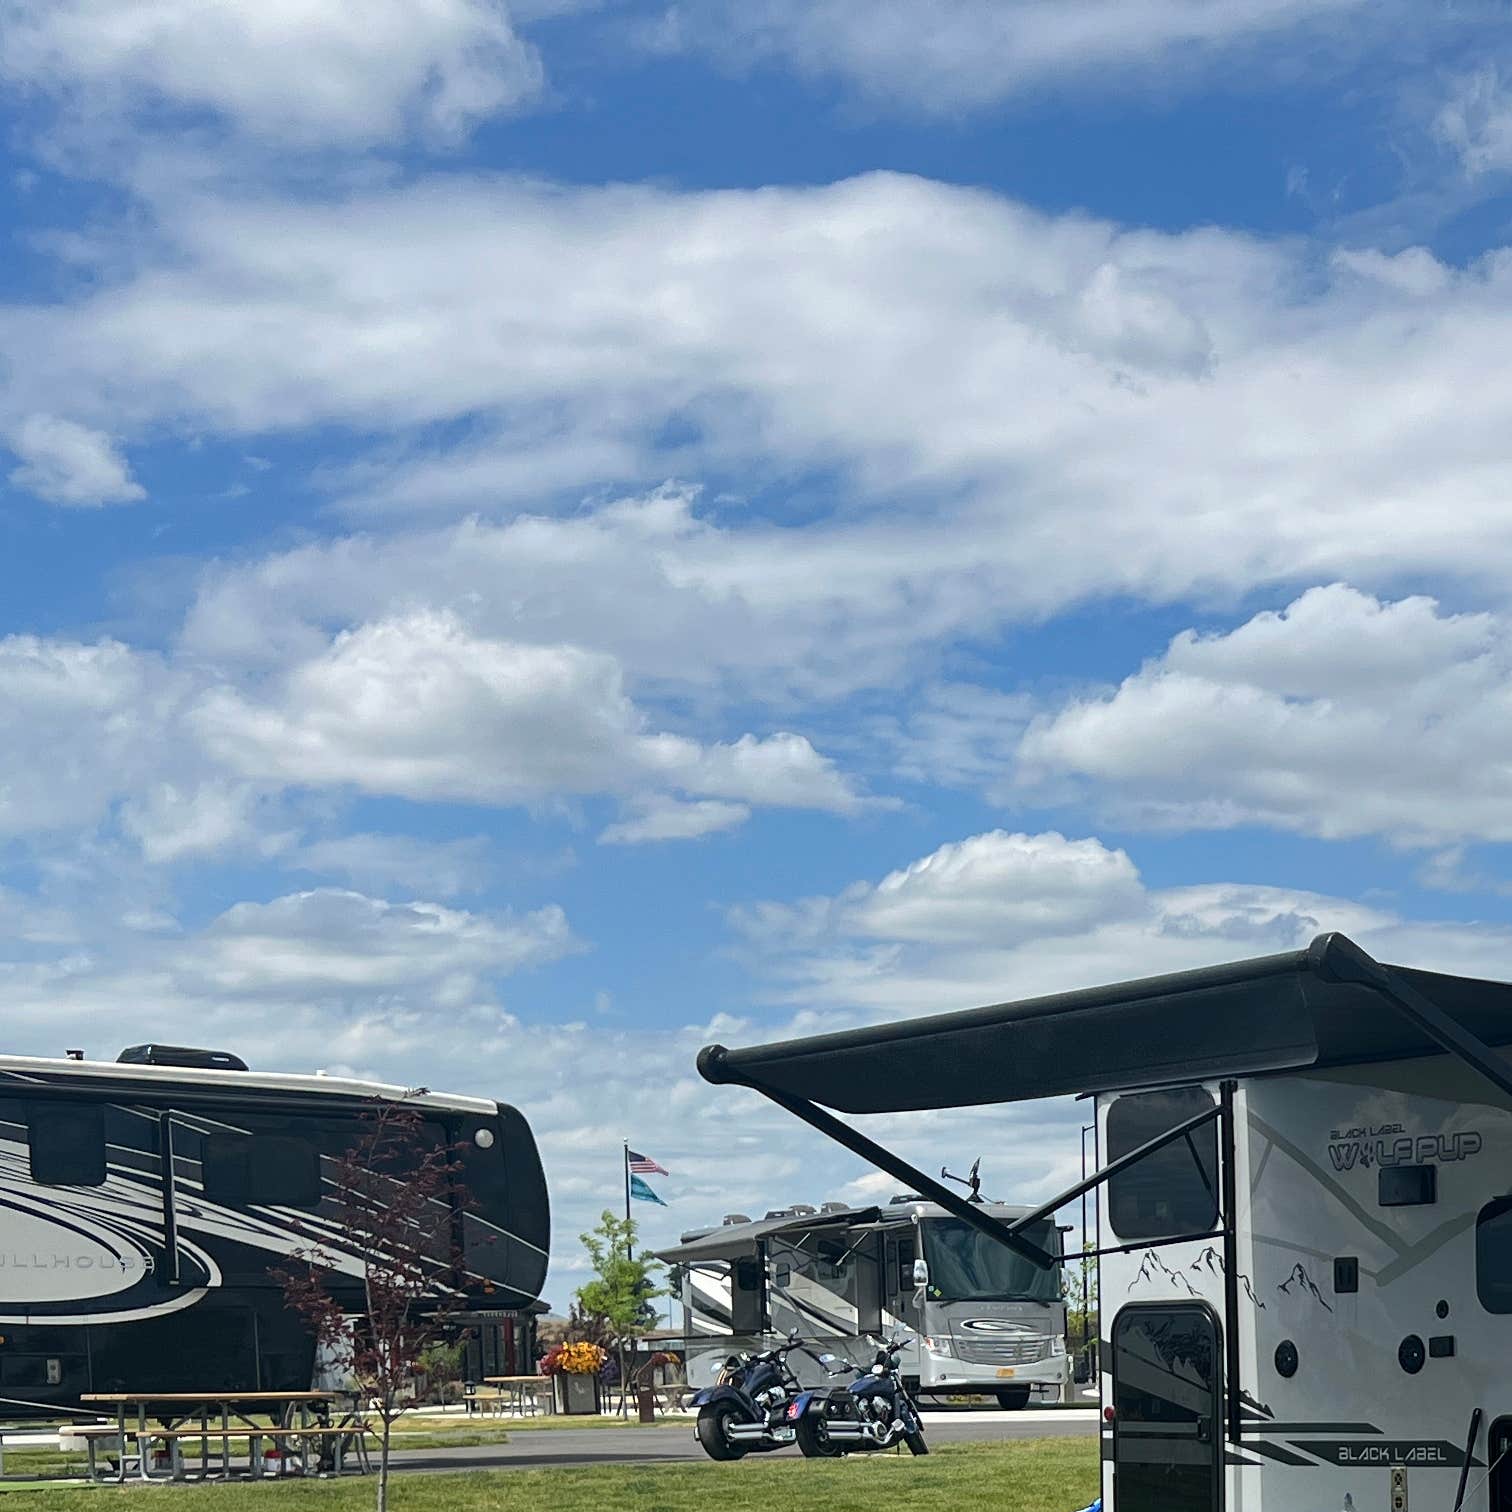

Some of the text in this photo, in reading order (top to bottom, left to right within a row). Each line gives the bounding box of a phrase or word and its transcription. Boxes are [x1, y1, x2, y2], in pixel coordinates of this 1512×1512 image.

[1330, 1124, 1406, 1140] BLACK LABEL
[1338, 1446, 1447, 1461] BLACK LABEL
